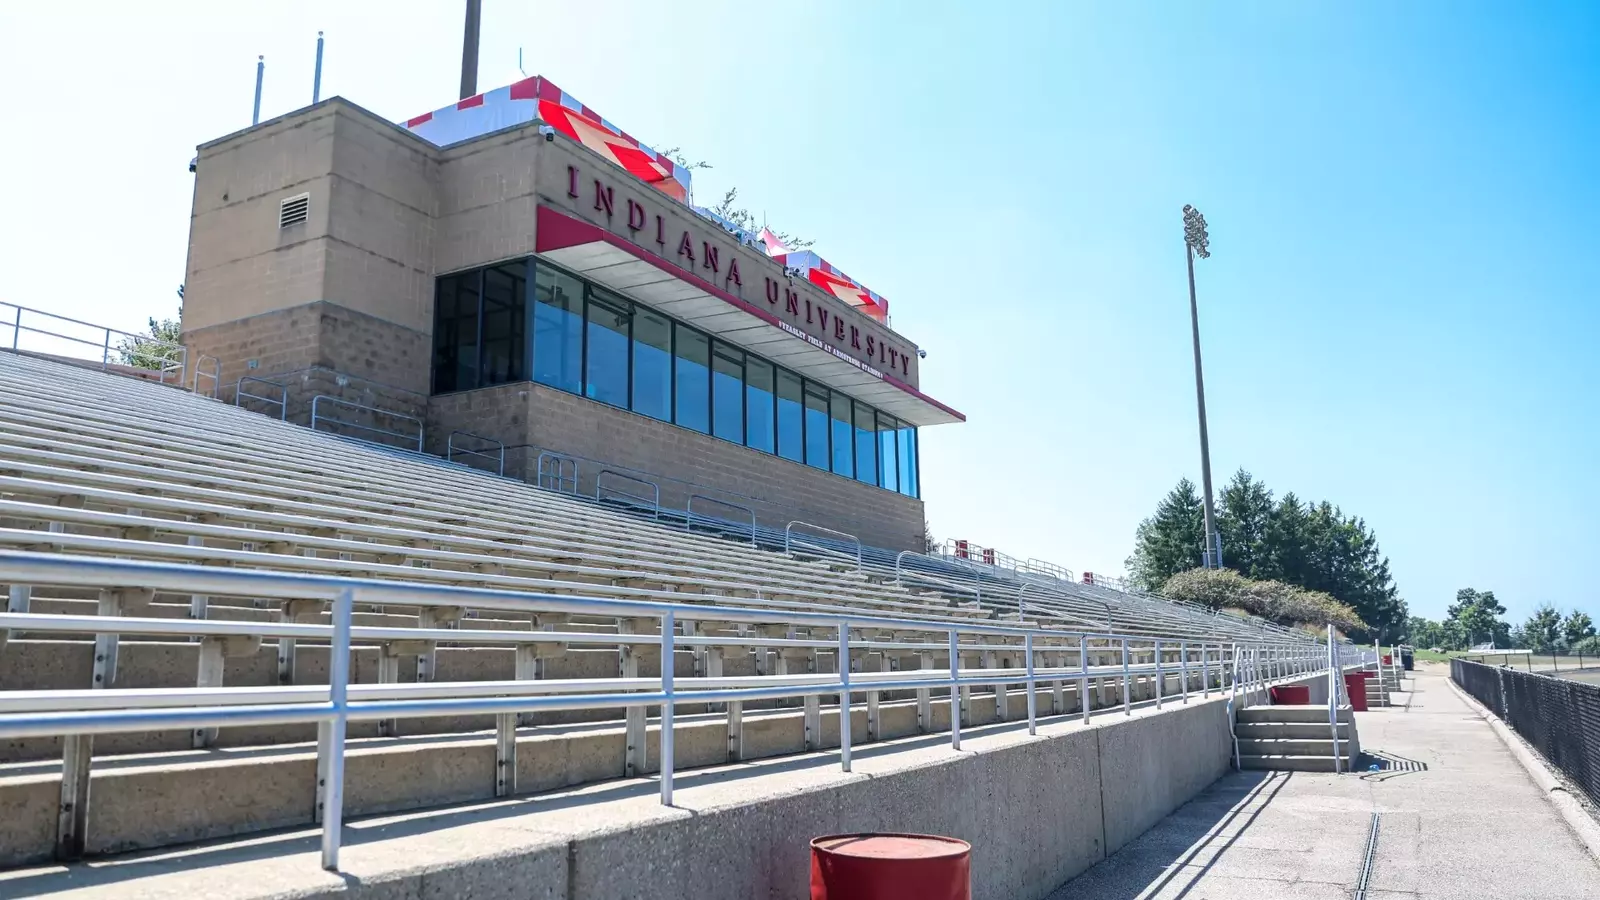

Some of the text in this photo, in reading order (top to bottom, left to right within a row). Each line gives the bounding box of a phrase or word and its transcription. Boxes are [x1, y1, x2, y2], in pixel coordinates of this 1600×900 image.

[567, 165, 909, 375] INDIANA UNIVERSITY
[808, 335, 823, 349] FIELD
[824, 344, 832, 353] AT
